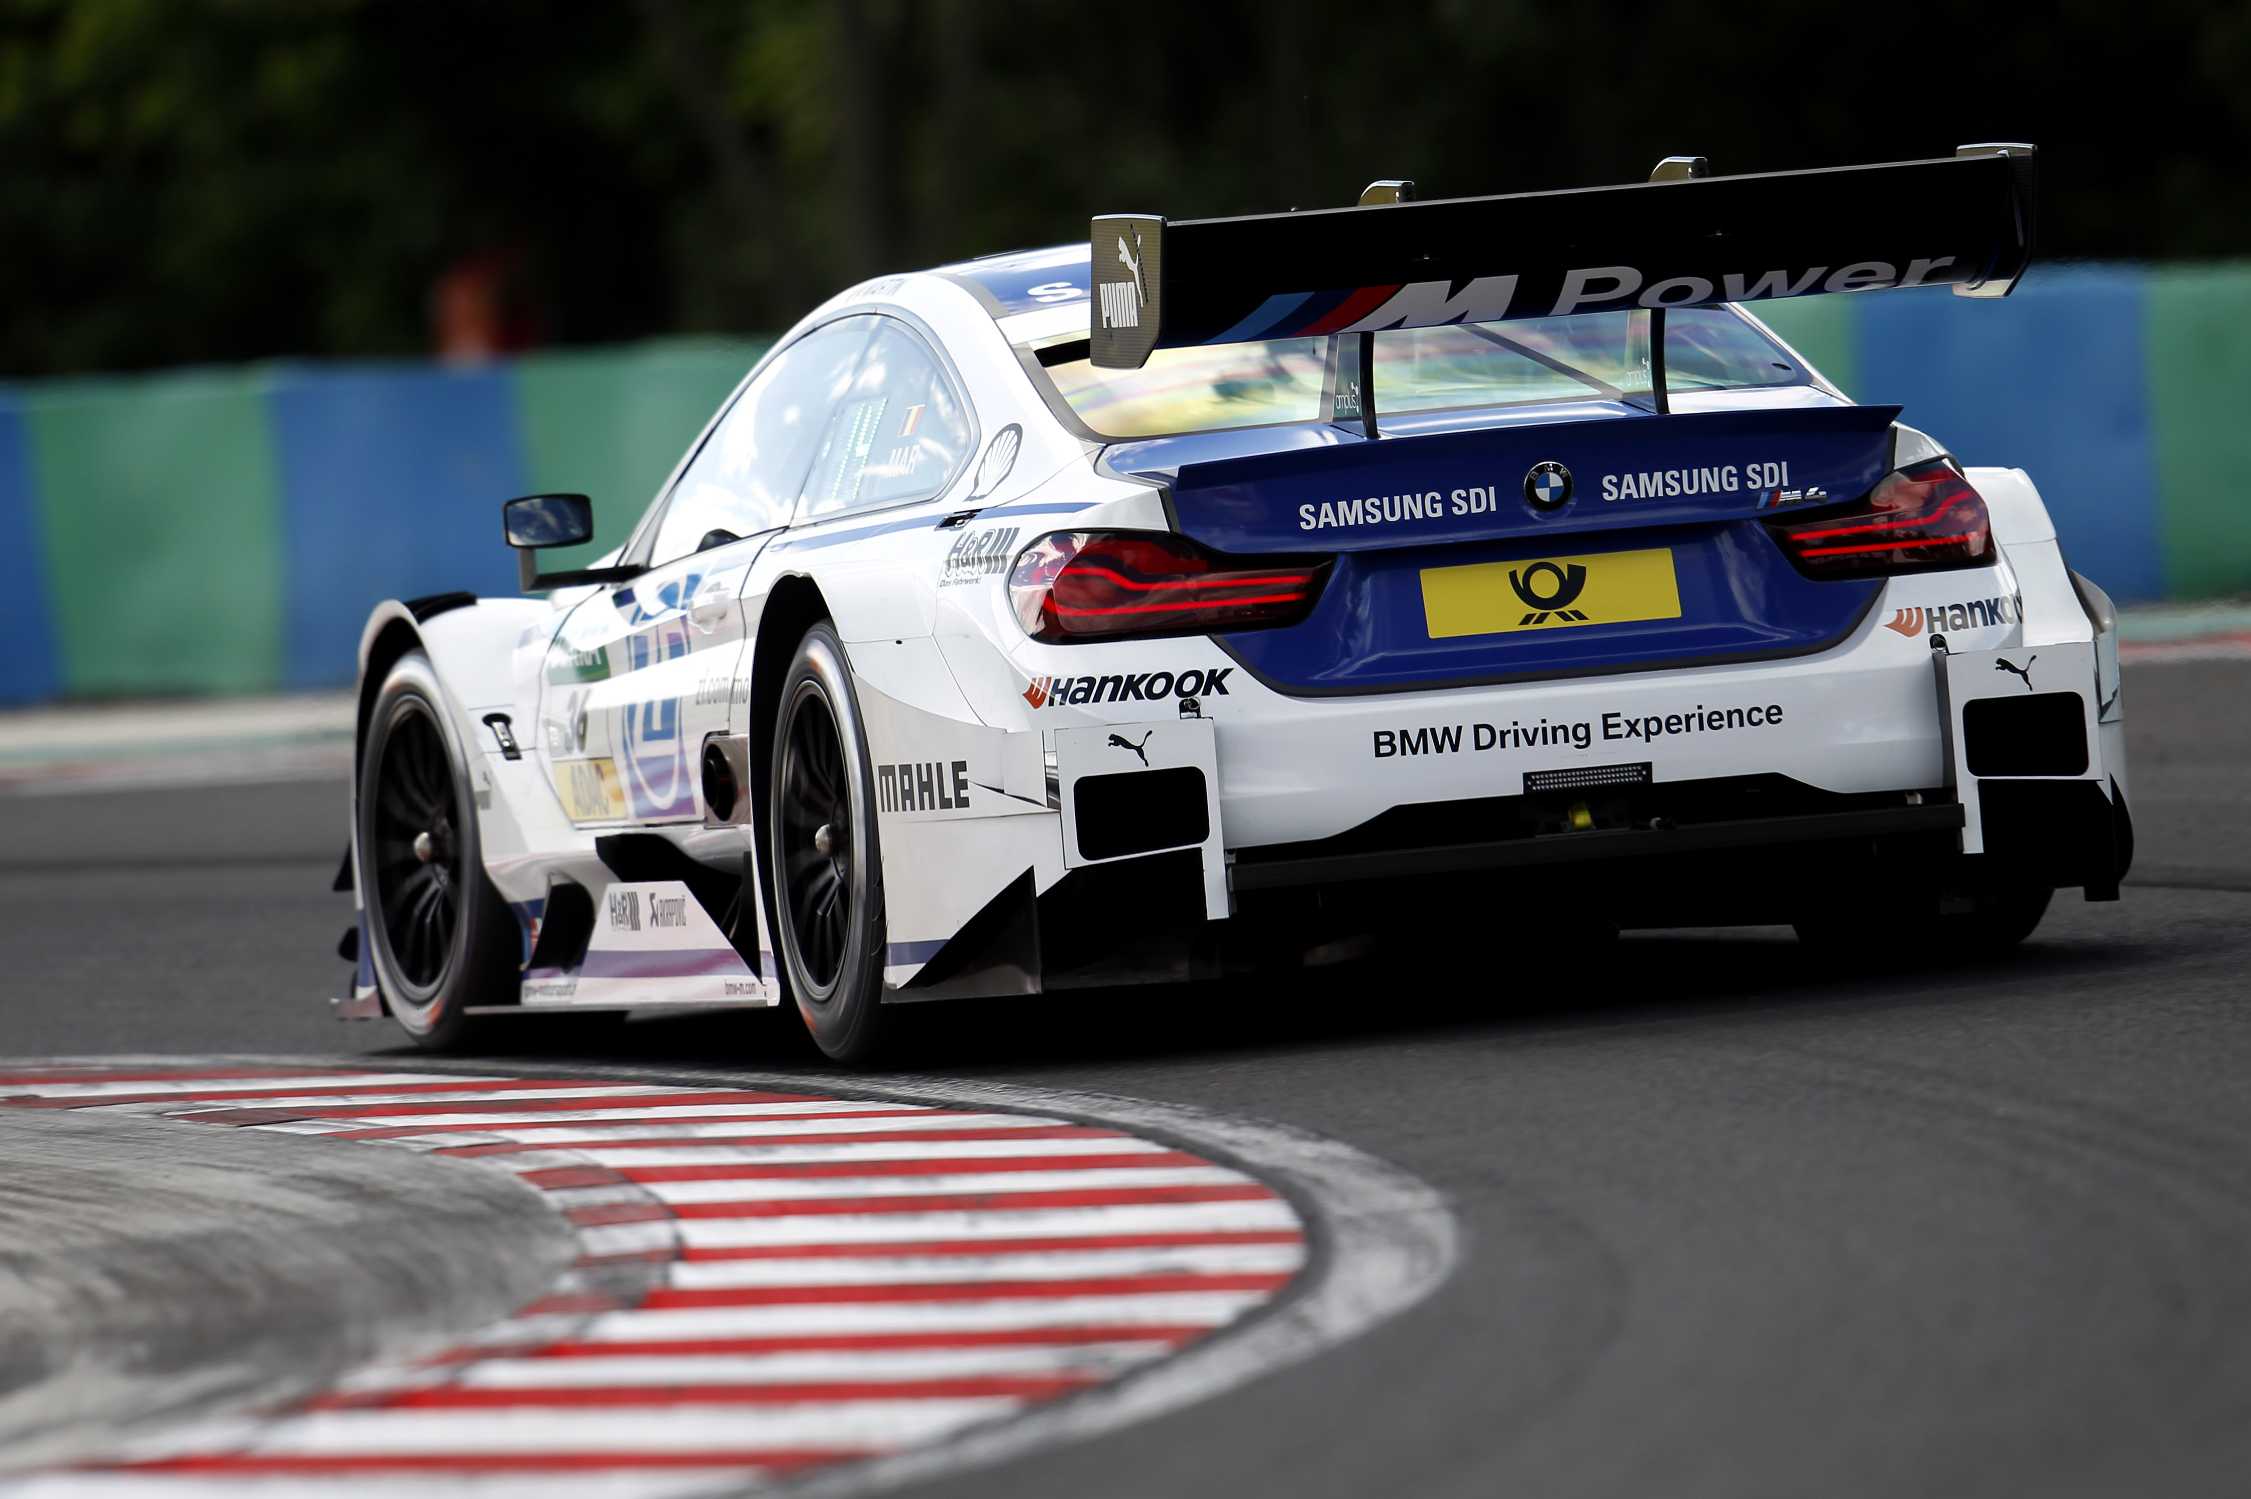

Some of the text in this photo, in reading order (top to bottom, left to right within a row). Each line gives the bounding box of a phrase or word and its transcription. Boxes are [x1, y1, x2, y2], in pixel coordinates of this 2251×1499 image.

[1100, 282, 1139, 329] PUMA
[1548, 255, 1956, 316] Power
[1602, 461, 1789, 502] SAMSUNG SDI
[1299, 486, 1497, 531] SAMSUNG SDI
[1373, 703, 1784, 758] BMW Driving Experience
[877, 760, 970, 813] MAHLE
